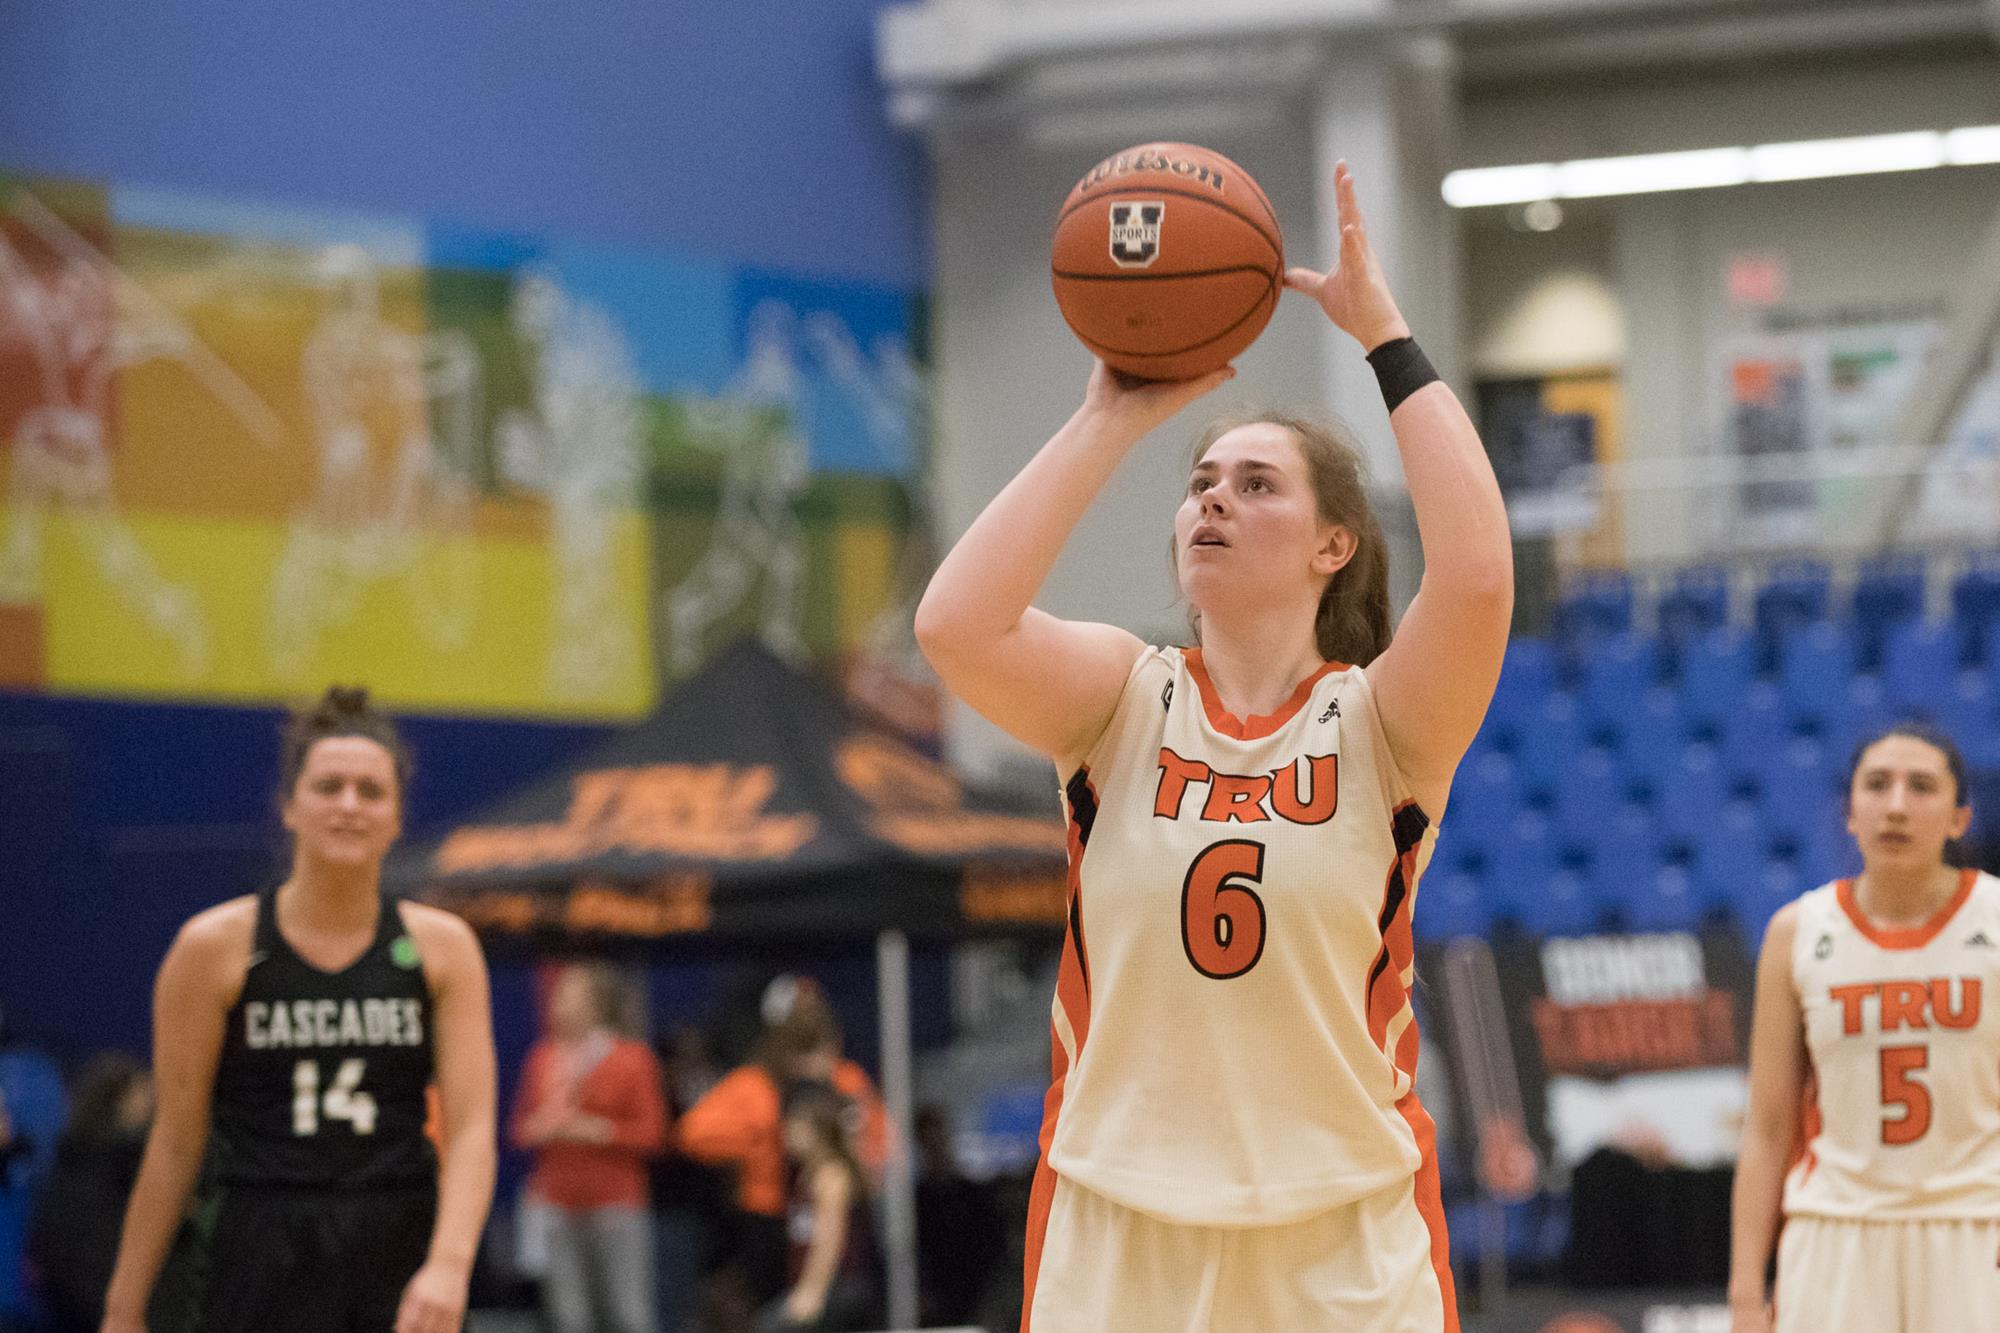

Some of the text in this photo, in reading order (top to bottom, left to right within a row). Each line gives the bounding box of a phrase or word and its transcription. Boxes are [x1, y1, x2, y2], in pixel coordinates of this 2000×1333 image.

[1112, 228, 1157, 241] SPORTS
[1153, 747, 1338, 825] TRU
[1180, 838, 1266, 980] 6
[245, 998, 424, 1049] CASCADES
[1828, 976, 1982, 1036] TRU
[292, 1058, 378, 1137] 14
[1879, 1044, 1933, 1146] 5
